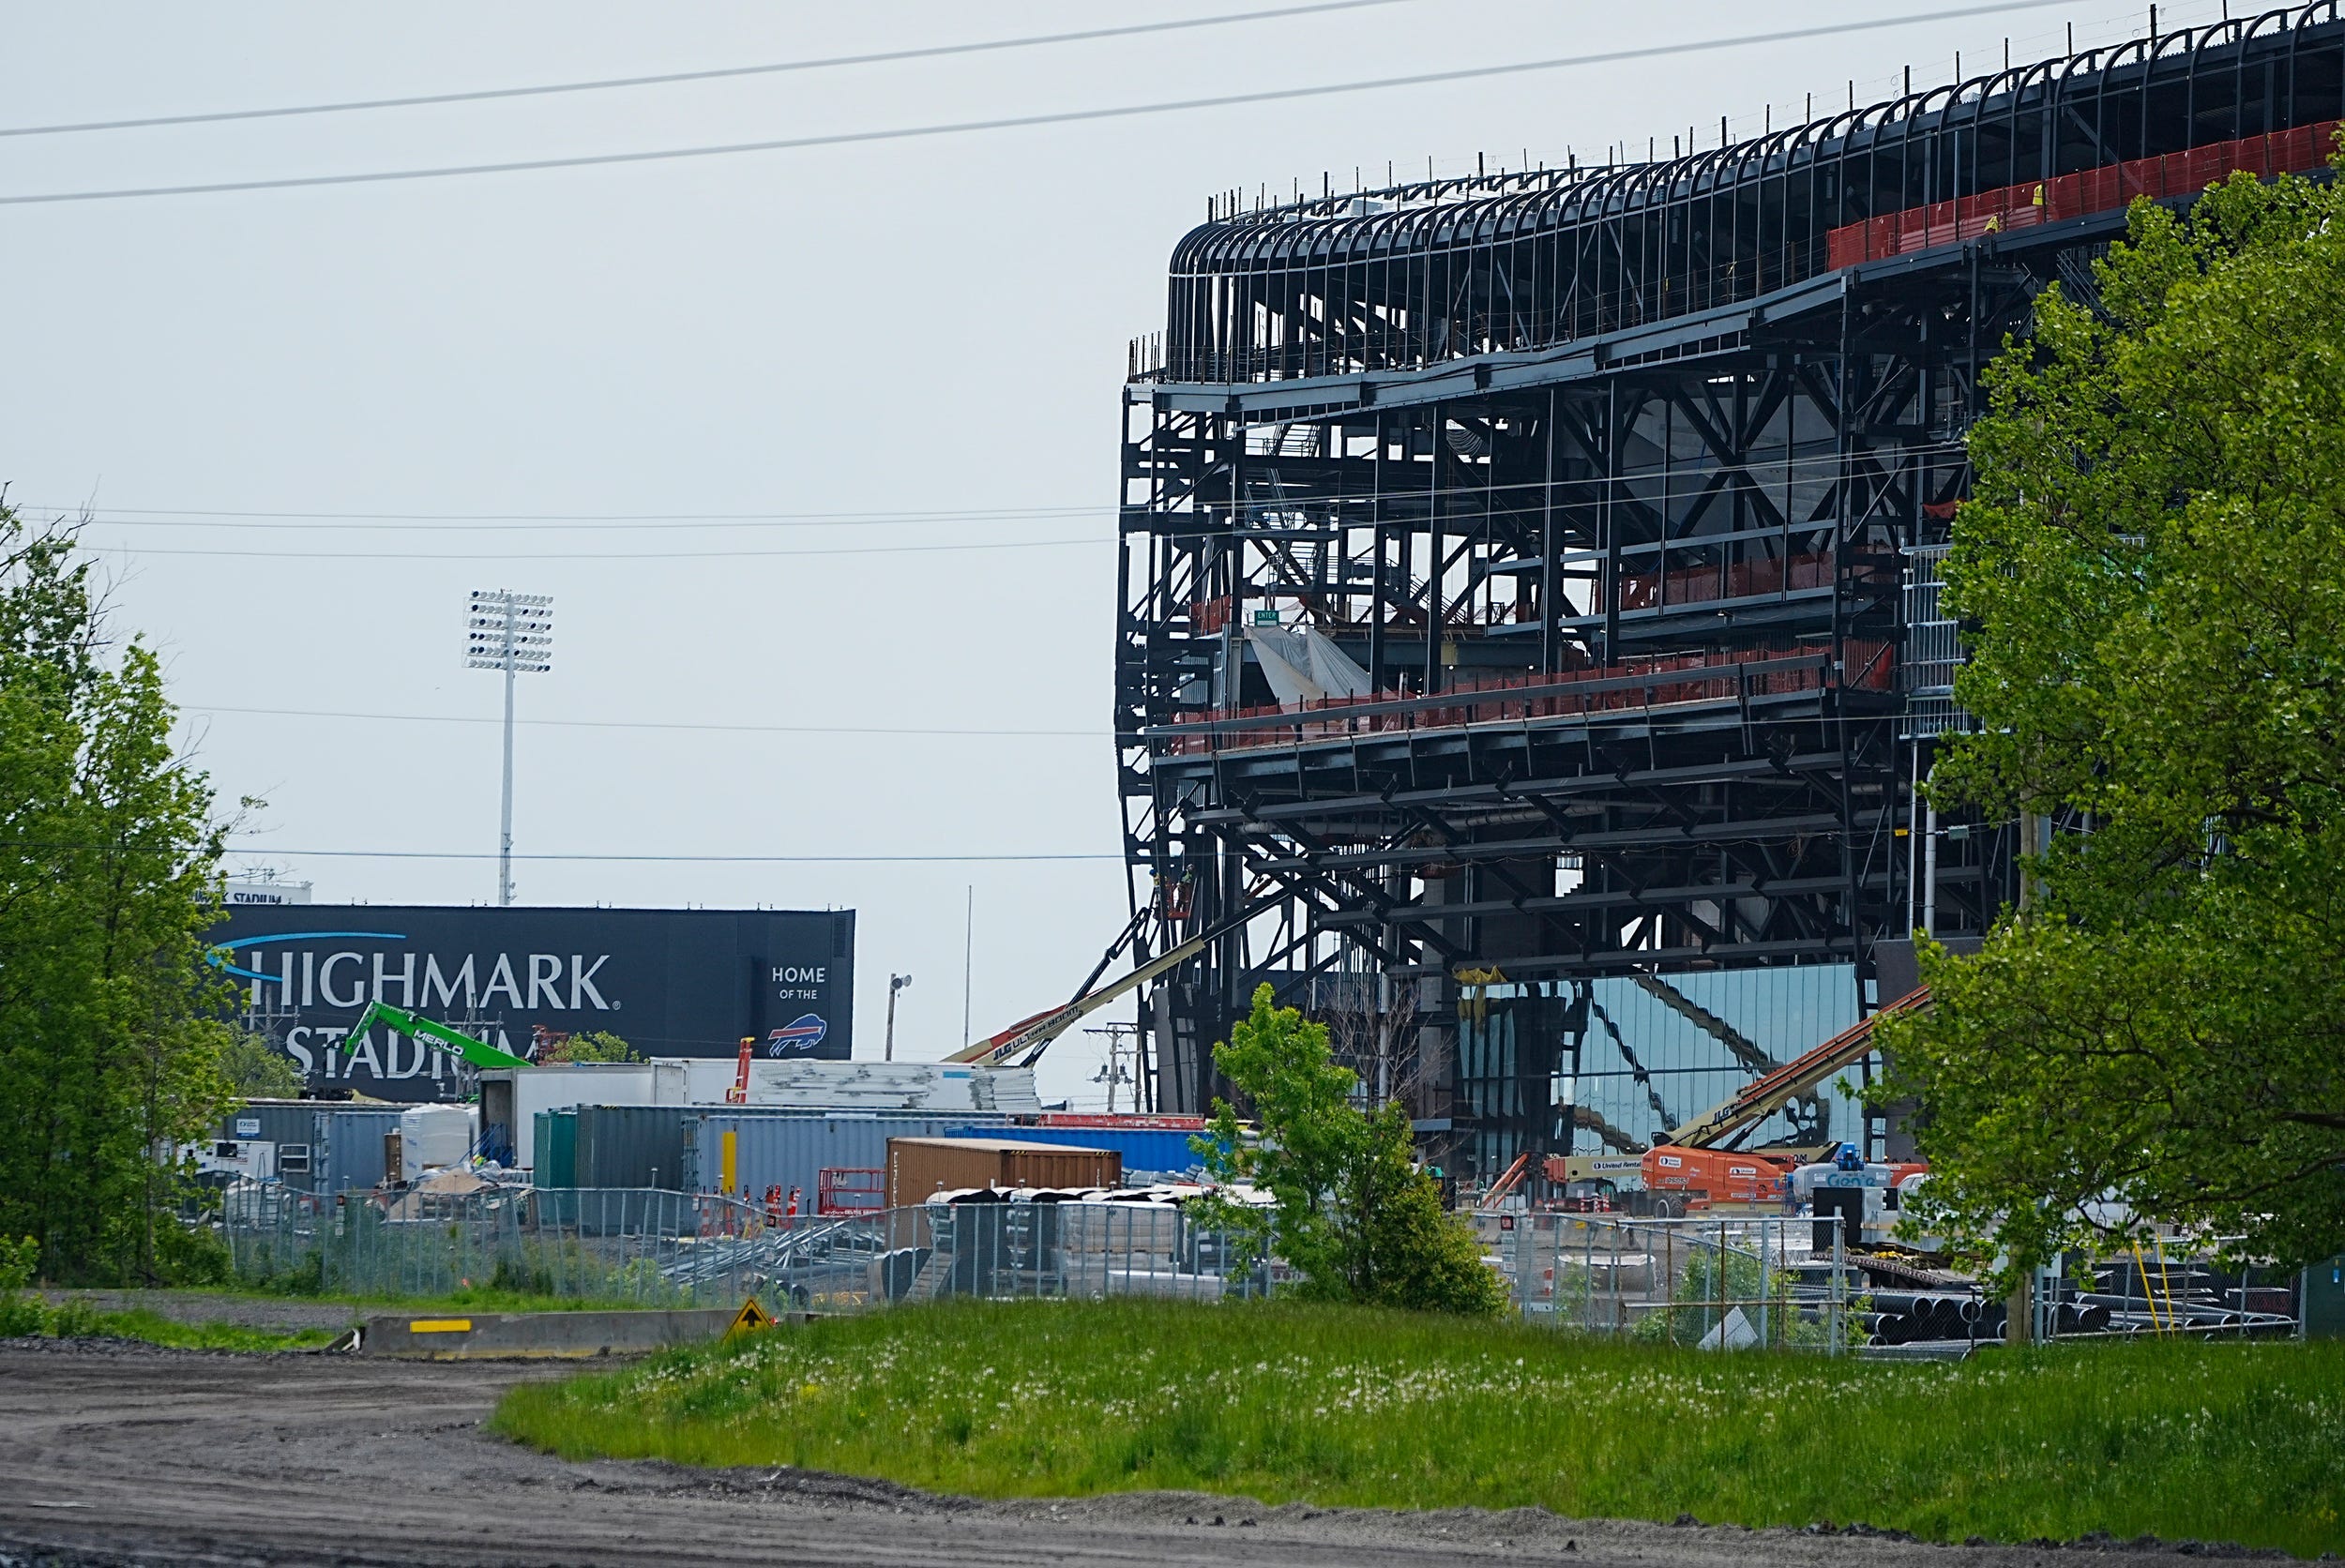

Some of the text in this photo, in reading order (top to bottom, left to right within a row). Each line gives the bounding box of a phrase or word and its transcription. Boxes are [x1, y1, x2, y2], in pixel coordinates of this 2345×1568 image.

[772, 967, 825, 983] HOME
[779, 989, 818, 1000] OF THE
[414, 1029, 464, 1056] MERLO
[285, 1025, 538, 1079] STADI
[993, 1043, 1012, 1061] JLG
[1827, 1174, 1876, 1186] Genie
